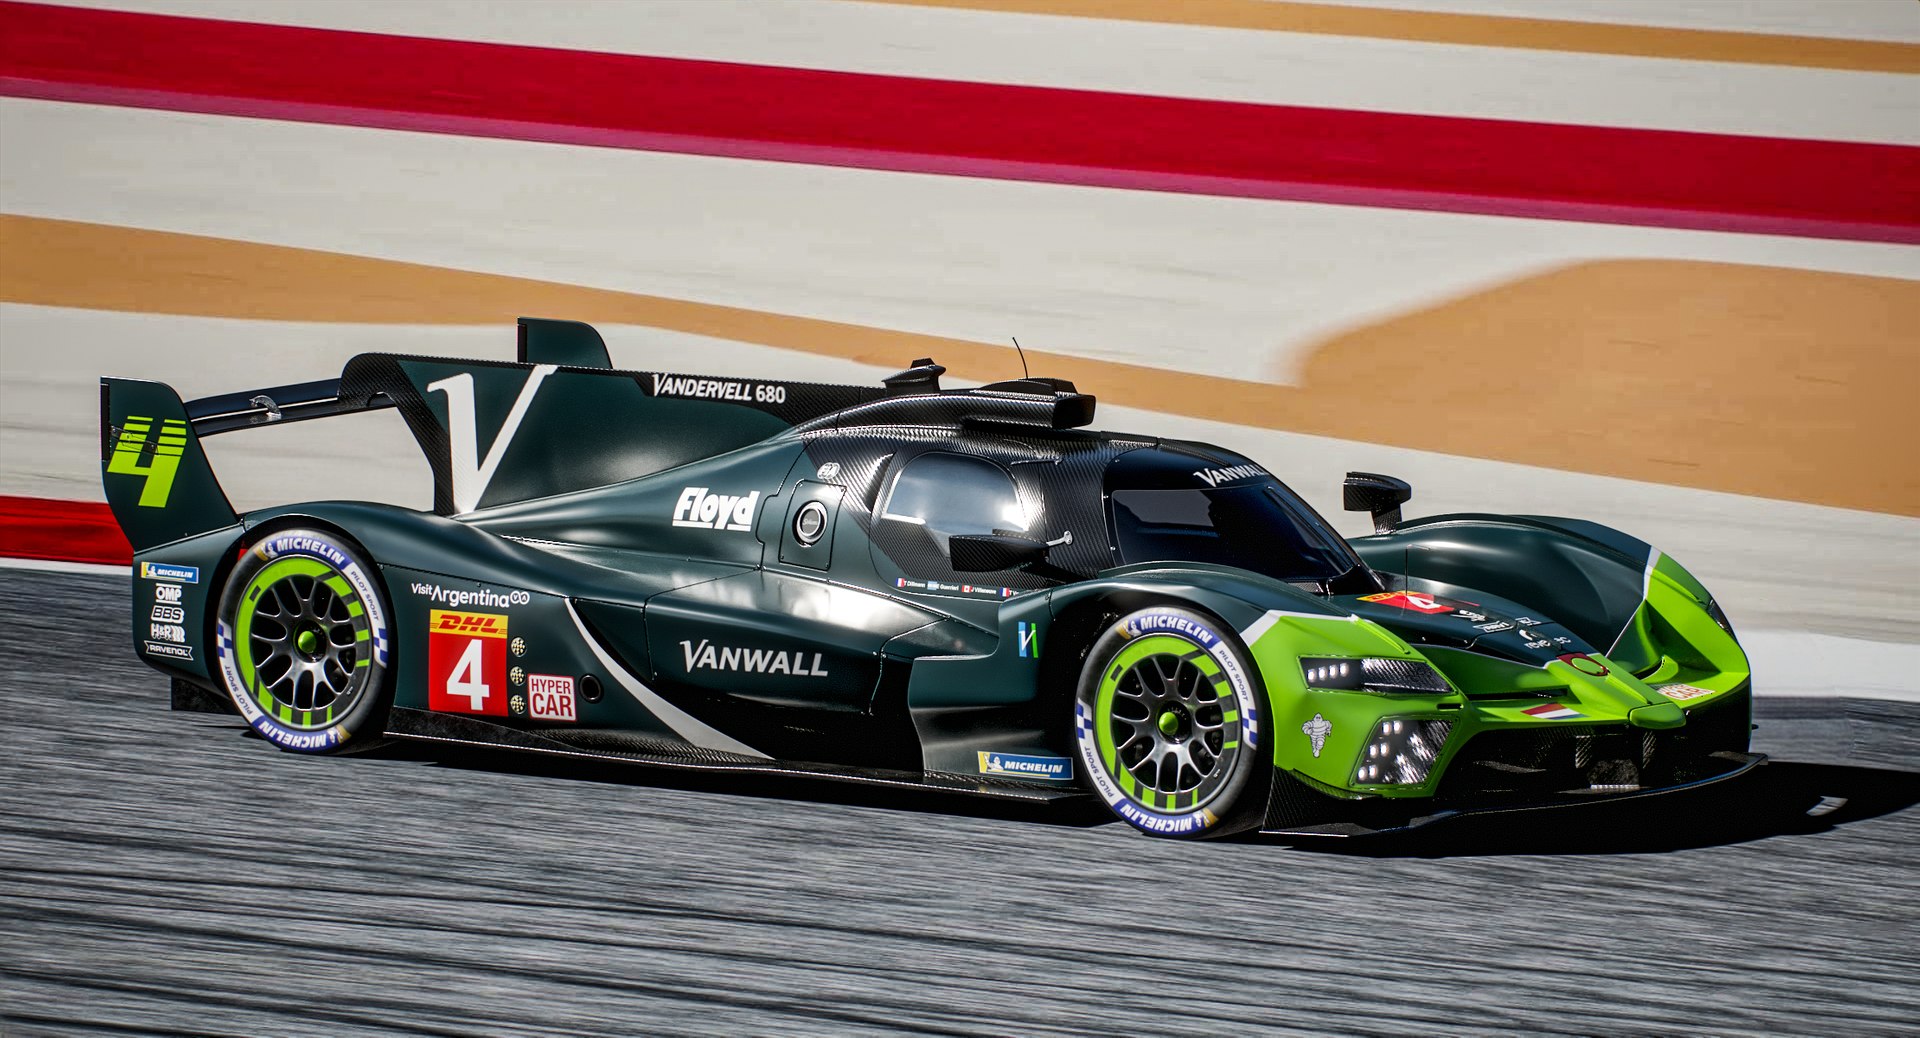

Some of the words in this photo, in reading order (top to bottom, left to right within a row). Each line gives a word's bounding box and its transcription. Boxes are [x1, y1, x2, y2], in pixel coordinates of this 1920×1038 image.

[652, 373, 752, 401] VANDERVELL
[755, 385, 786, 404] 680
[107, 415, 187, 508] 4
[672, 487, 760, 532] Floyd
[276, 537, 345, 565] MICHELIN
[157, 569, 193, 578] MICHELIN
[156, 586, 181, 601] OMP
[350, 571, 368, 594] PILOT
[365, 594, 380, 622] SPORT
[152, 606, 182, 621] BBS
[439, 614, 499, 634] DHL
[1140, 615, 1213, 644] MICHELIN
[149, 645, 188, 656] RAVENOL
[679, 639, 829, 677] VANWALL
[224, 666, 239, 692] SPORT
[446, 638, 490, 711] 4
[531, 678, 571, 694] HYPER
[1219, 650, 1236, 673] PILOT
[1234, 673, 1250, 702] SPORT
[236, 692, 253, 715] PILOT
[532, 693, 573, 717] CAR
[258, 720, 327, 749] MICHELIN
[1004, 761, 1063, 773] MICHELIN
[1084, 745, 1099, 774] SPORT
[1097, 775, 1115, 798] PILOT
[1120, 802, 1193, 833] MICHELIN
